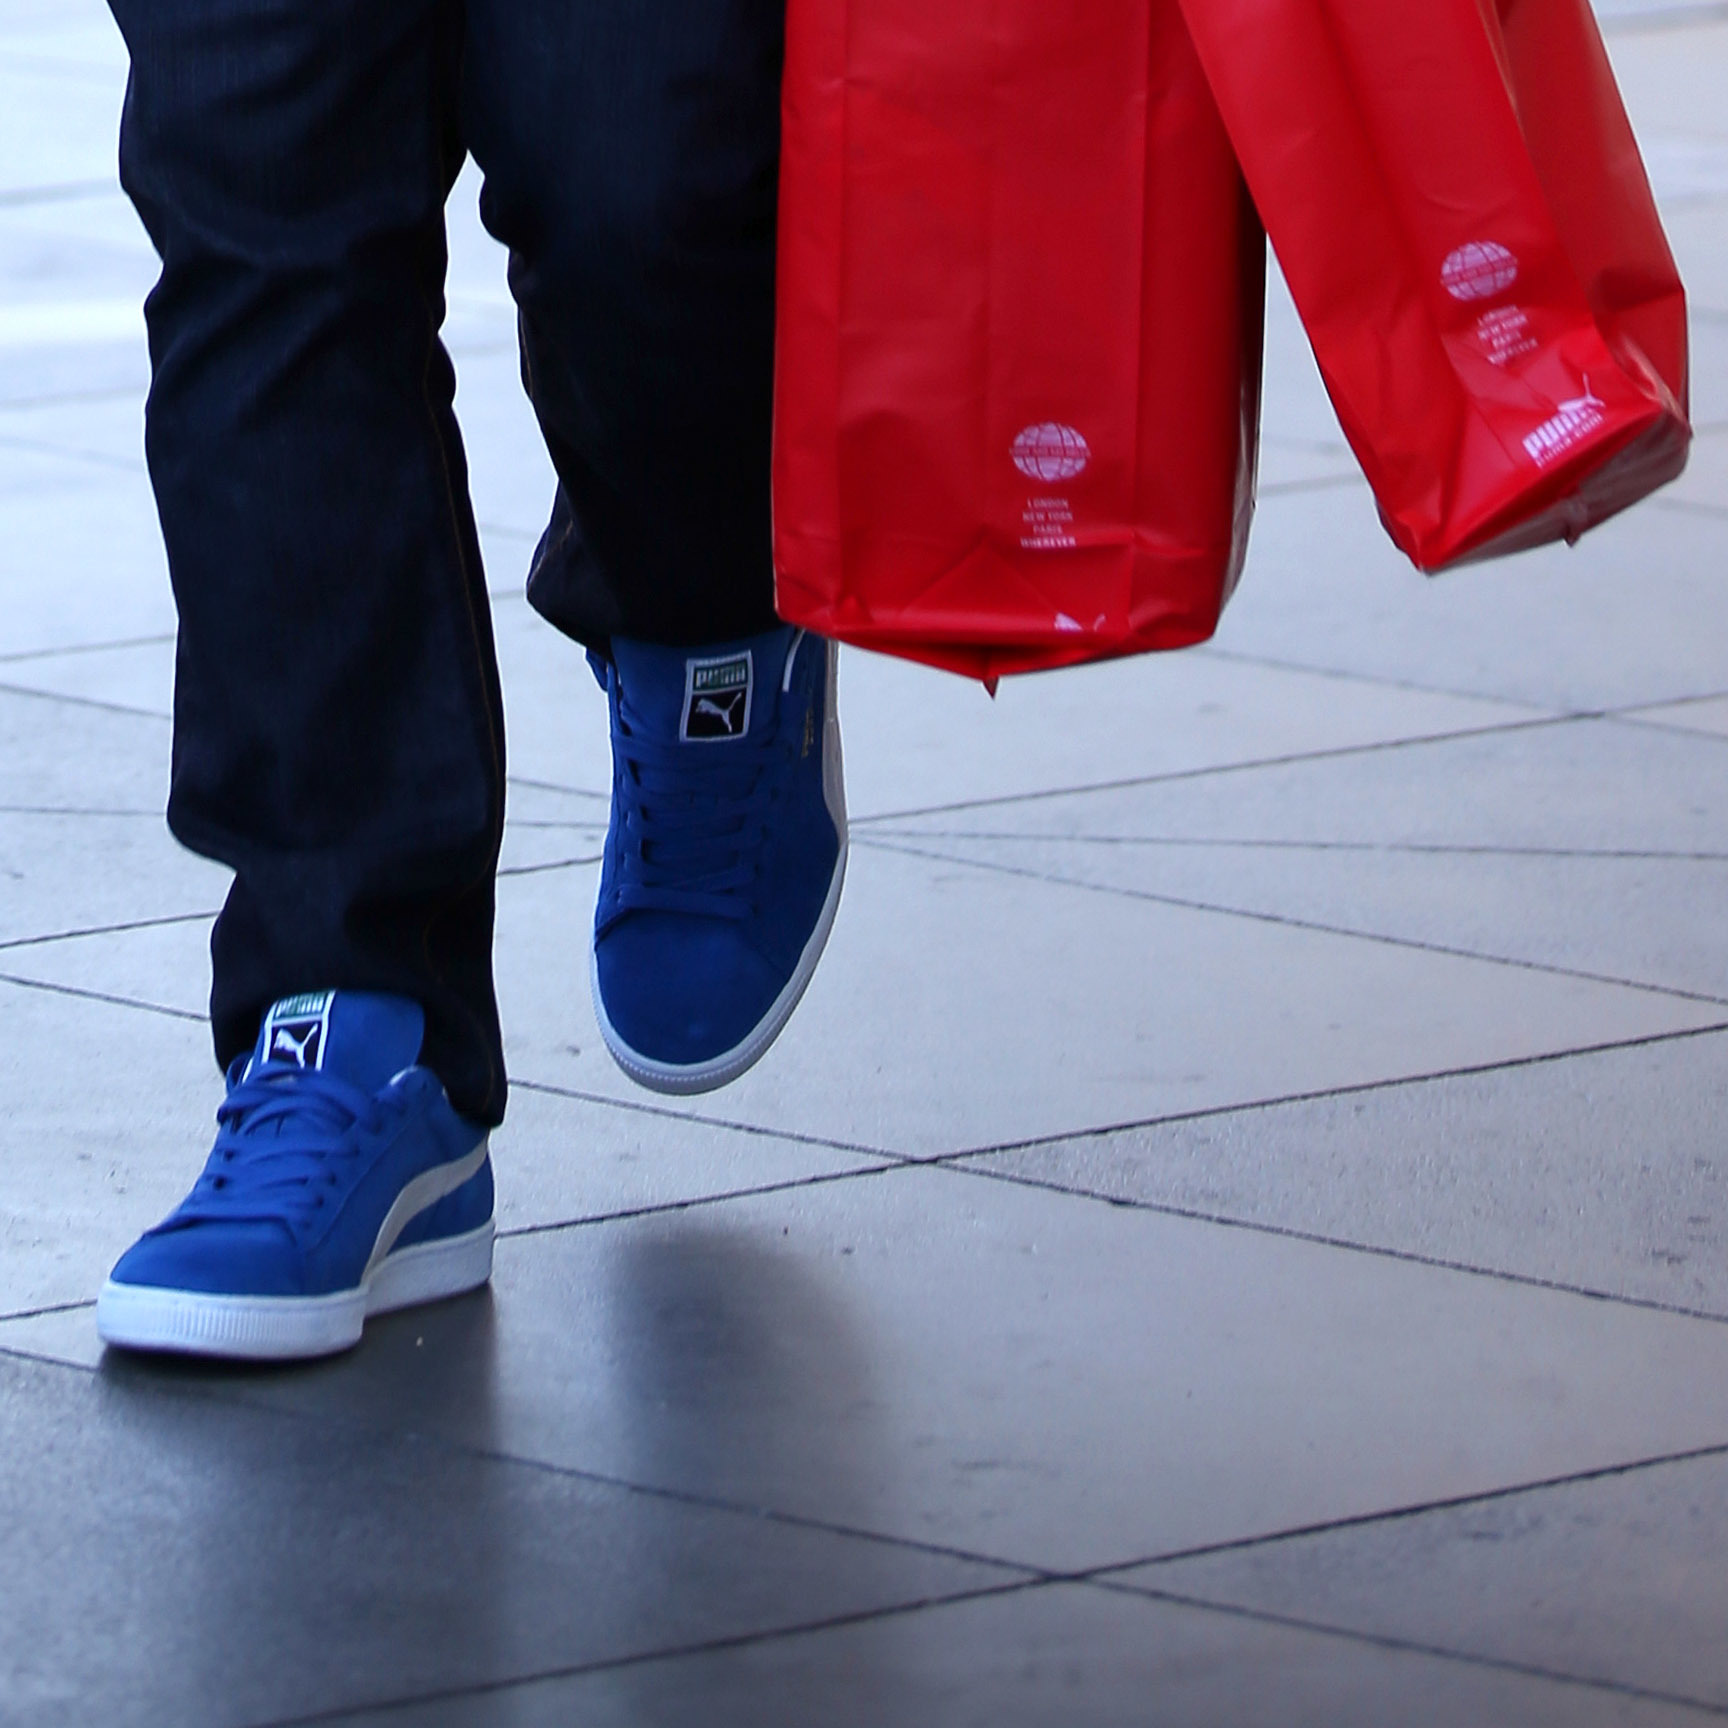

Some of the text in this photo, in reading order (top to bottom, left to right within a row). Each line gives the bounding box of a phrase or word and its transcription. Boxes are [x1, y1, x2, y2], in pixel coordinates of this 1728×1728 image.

[1027, 497, 1069, 510] LONDON
[1022, 511, 1073, 522] NEW YORK
[1033, 523, 1063, 535] PARIS
